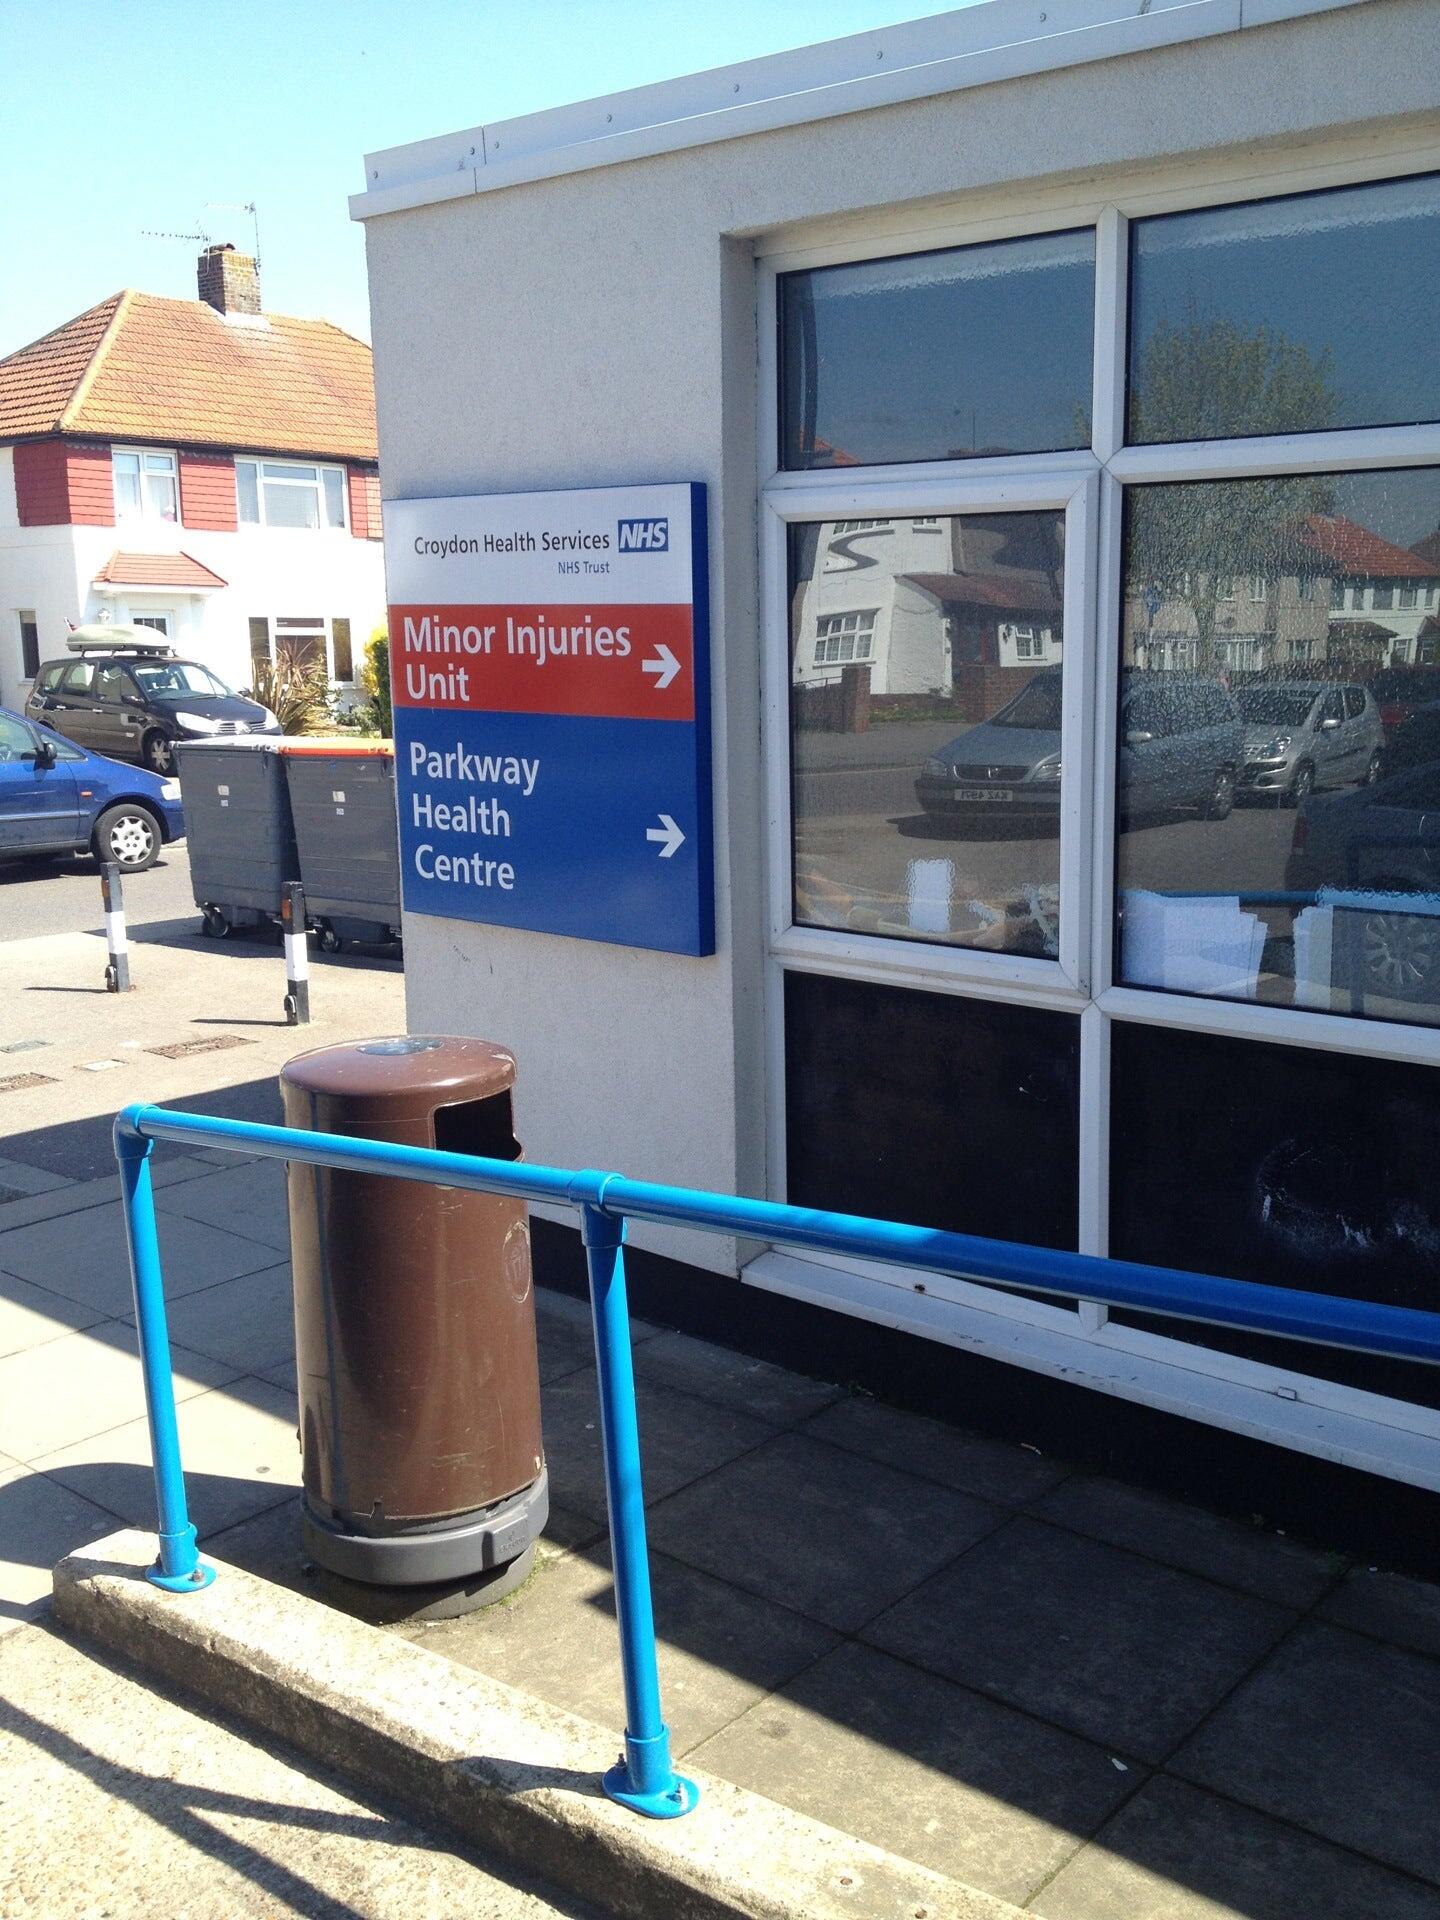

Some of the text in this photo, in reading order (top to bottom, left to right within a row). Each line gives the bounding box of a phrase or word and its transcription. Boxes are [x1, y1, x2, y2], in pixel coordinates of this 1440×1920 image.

[414, 530, 610, 559] Croydon Health Services
[619, 521, 667, 549] NHS
[558, 560, 610, 574] NHS Trust
[403, 614, 632, 666] Minor Injuries
[406, 663, 470, 702] Unit
[409, 741, 540, 796] Parkway
[413, 793, 511, 837] Health
[415, 844, 515, 890] Centre
